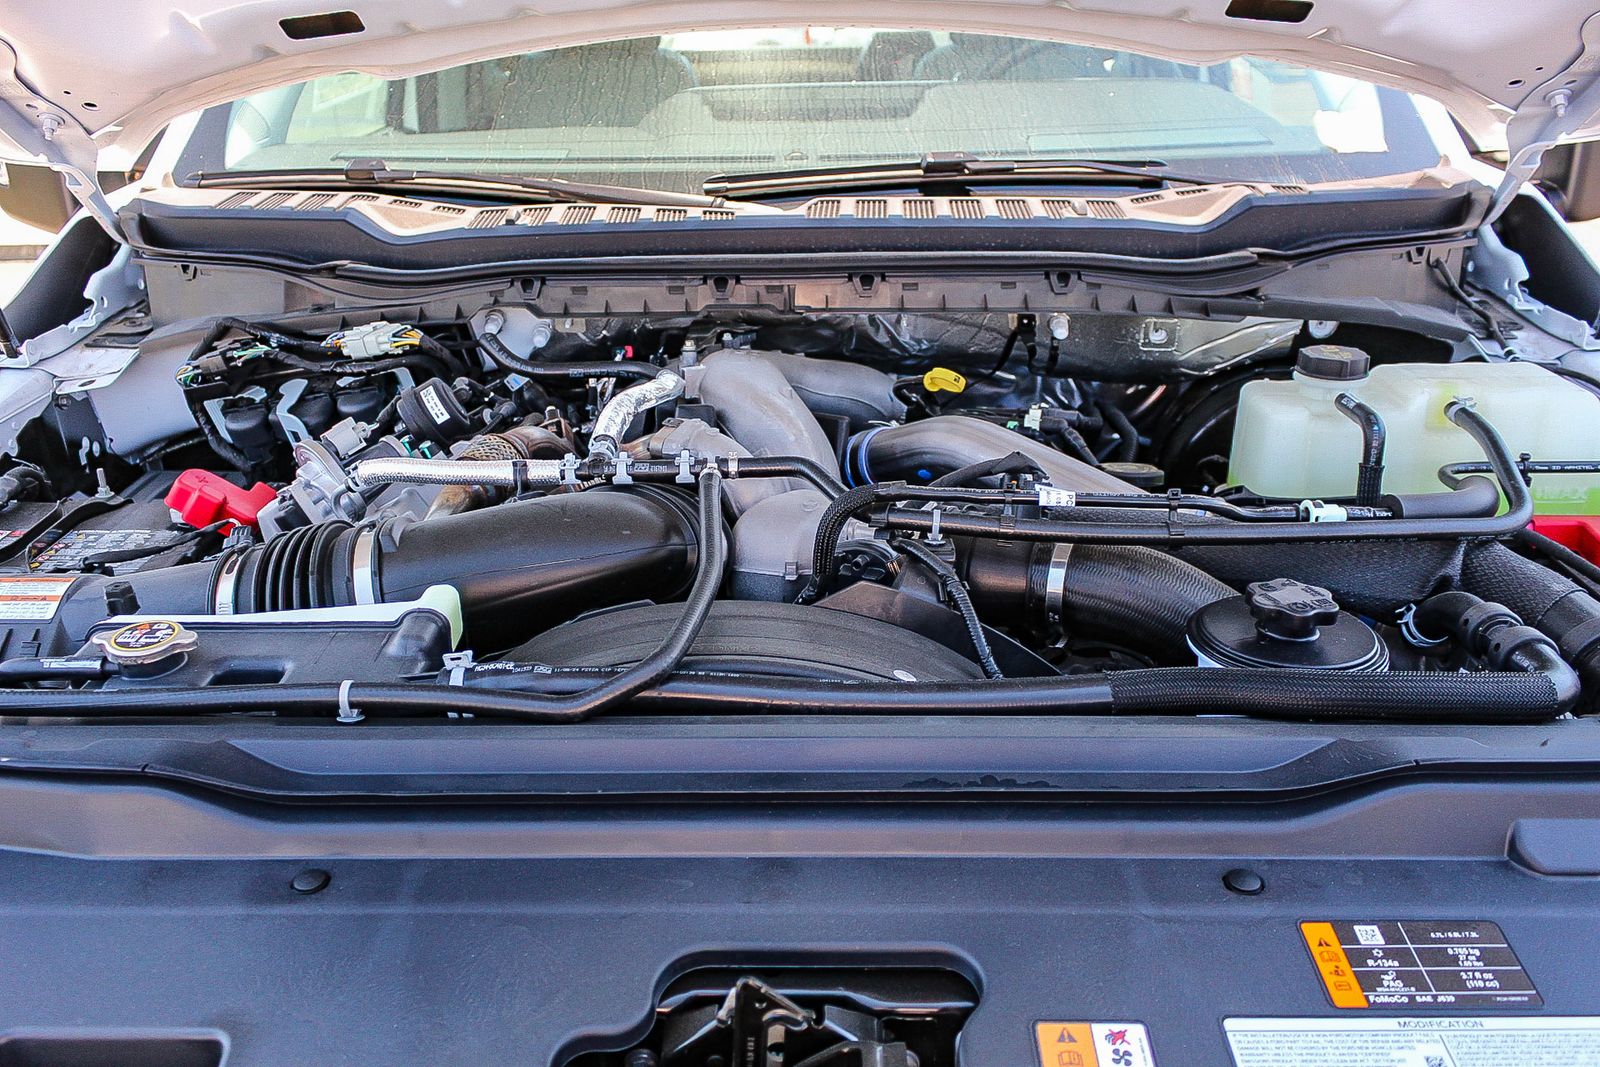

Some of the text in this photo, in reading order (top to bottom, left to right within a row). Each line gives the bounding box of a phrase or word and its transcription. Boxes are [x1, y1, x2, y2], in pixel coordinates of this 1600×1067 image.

[1366, 959, 1400, 967] R-134a
[1382, 980, 1404, 988] PAG
[1368, 995, 1409, 1003] FoMoCo
[1397, 1020, 1485, 1029] MODIFICATION
